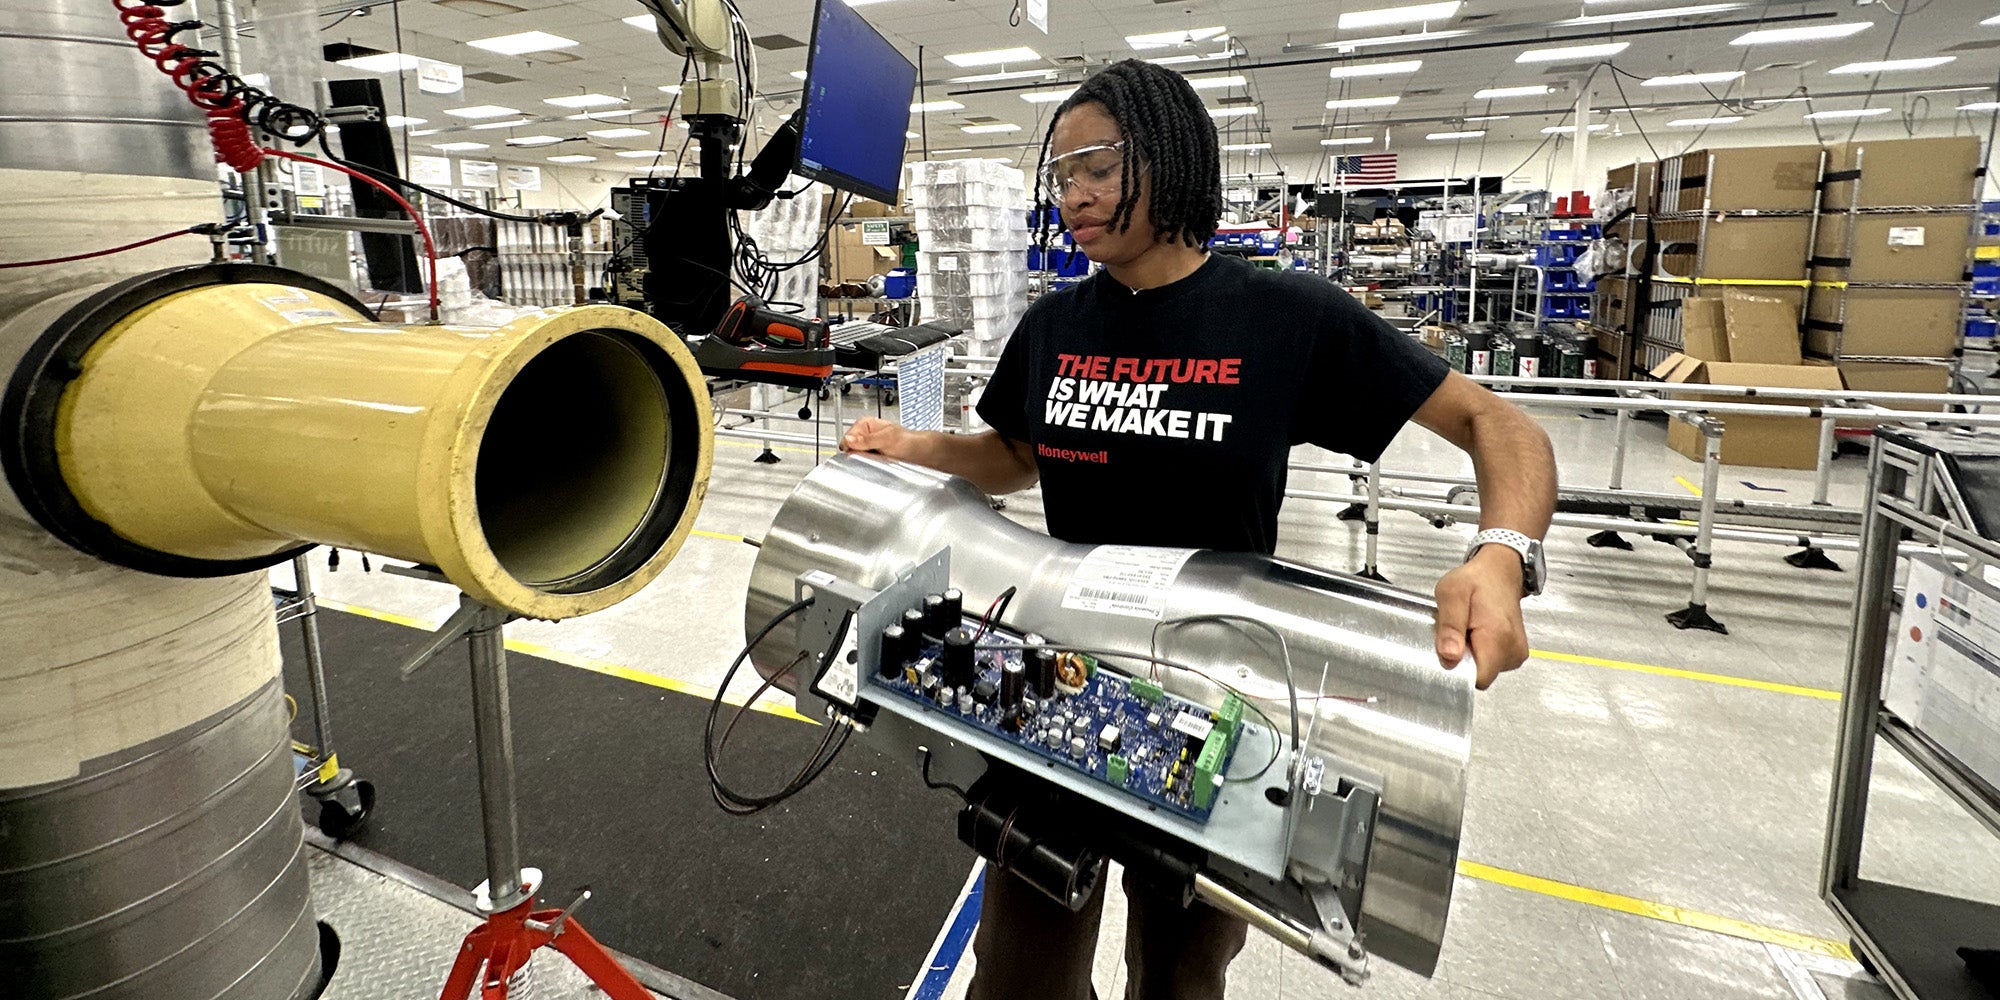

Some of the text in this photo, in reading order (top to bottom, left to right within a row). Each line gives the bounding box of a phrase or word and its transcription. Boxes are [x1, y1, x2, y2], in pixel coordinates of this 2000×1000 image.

[1057, 354, 1242, 384] THE FUTURE
[1048, 376, 1169, 408] IS WHAT
[1045, 400, 1233, 442] WE MAKE IT
[1037, 443, 1108, 464] Honeywell
